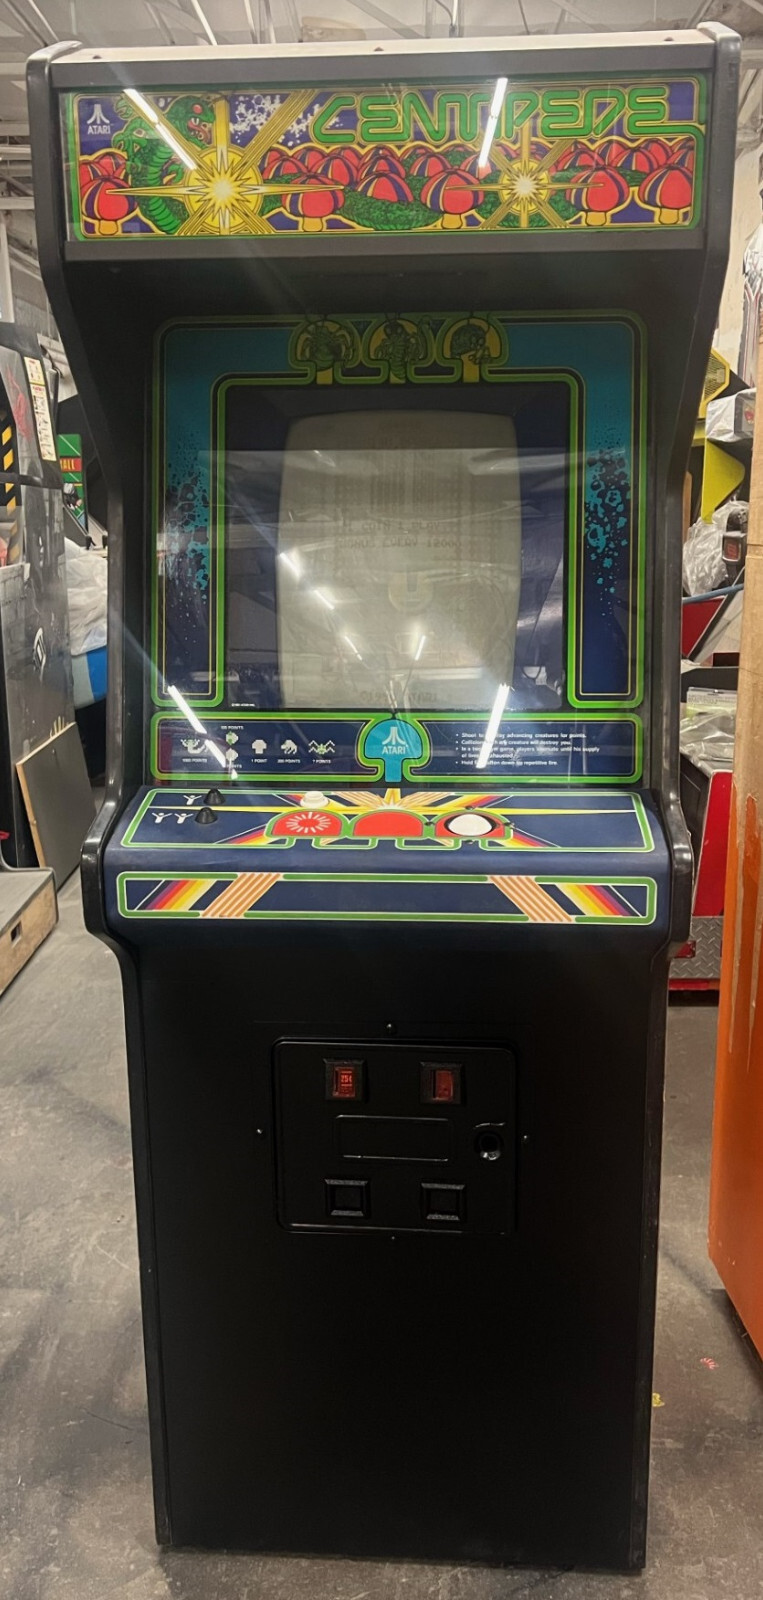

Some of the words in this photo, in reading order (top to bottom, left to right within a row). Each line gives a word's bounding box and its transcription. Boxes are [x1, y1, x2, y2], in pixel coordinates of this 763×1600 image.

[311, 87, 668, 143] CENTPEDE
[87, 125, 111, 135] ATARI
[382, 746, 406, 755] ATARI
